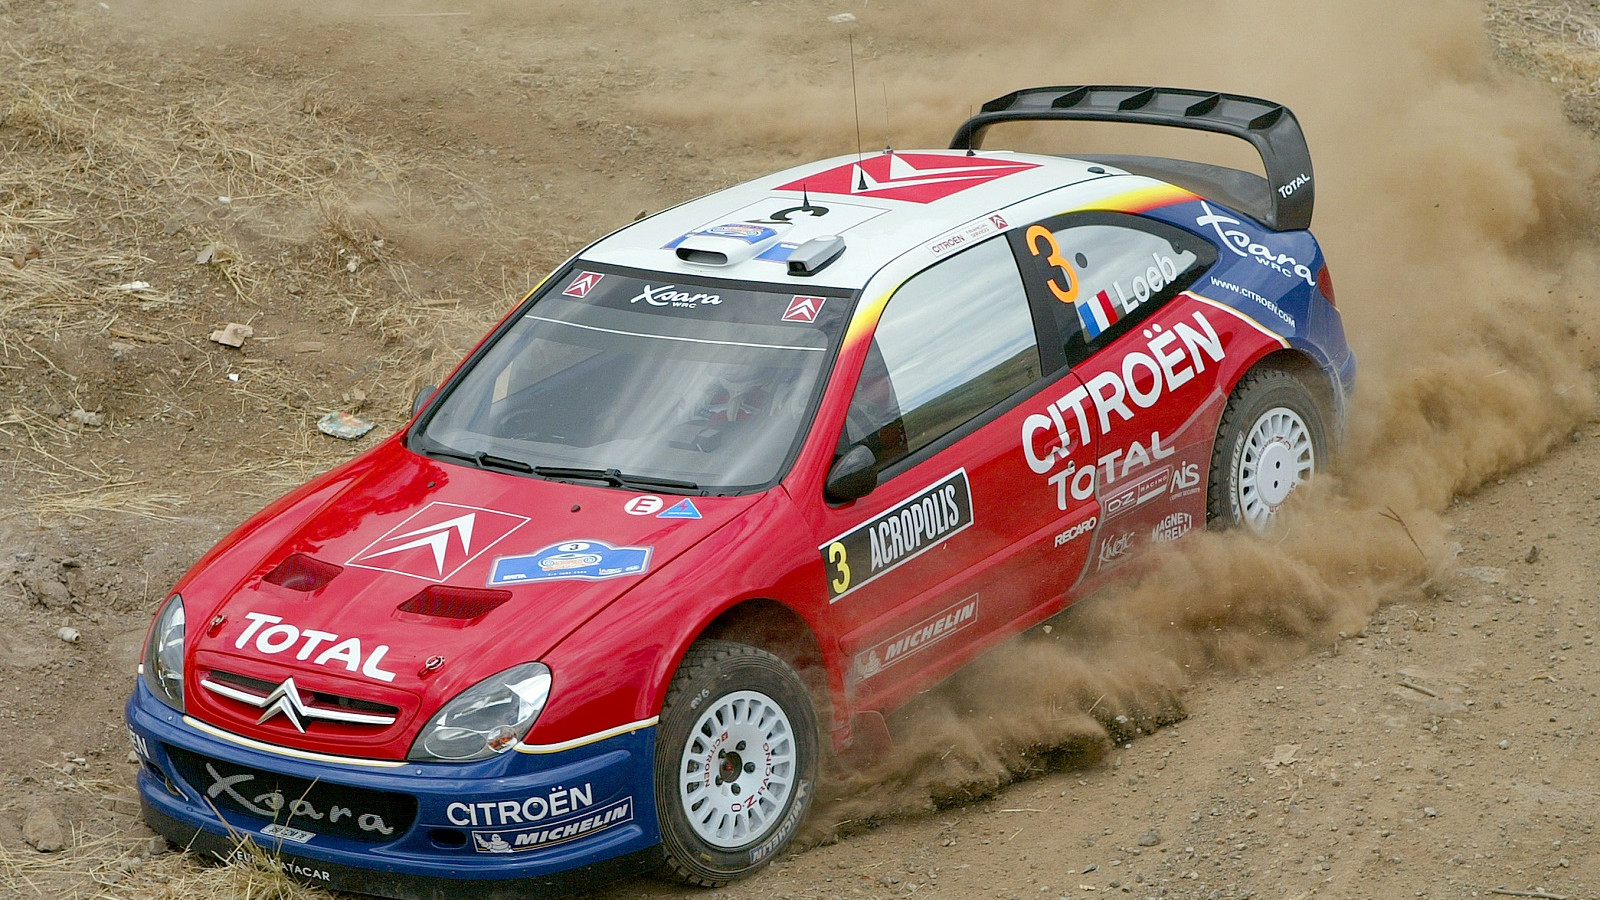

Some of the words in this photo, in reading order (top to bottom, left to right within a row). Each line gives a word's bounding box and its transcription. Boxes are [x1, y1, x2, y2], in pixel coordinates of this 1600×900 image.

[1278, 173, 1311, 199] TOTAL
[1026, 225, 1080, 304] 3
[1196, 200, 1316, 287] Xsara
[1255, 256, 1292, 278] WRC
[630, 284, 723, 306] Xsara
[1113, 252, 1178, 315] Loeb
[1021, 310, 1226, 475] CITROËN
[1048, 431, 1175, 511] TOTAL
[1140, 475, 1168, 493] RACING
[568, 543, 579, 551] 3
[869, 485, 960, 572] ACROPOLIS
[1054, 516, 1098, 548] RECARO
[828, 542, 851, 594] 3
[234, 611, 397, 683] TOTAL
[885, 602, 975, 661] MICHELIN
[205, 762, 394, 835] Xsara
[446, 782, 594, 827] CITROËN
[514, 804, 630, 848] MICHELIN
[752, 800, 803, 863] MICHELIN
